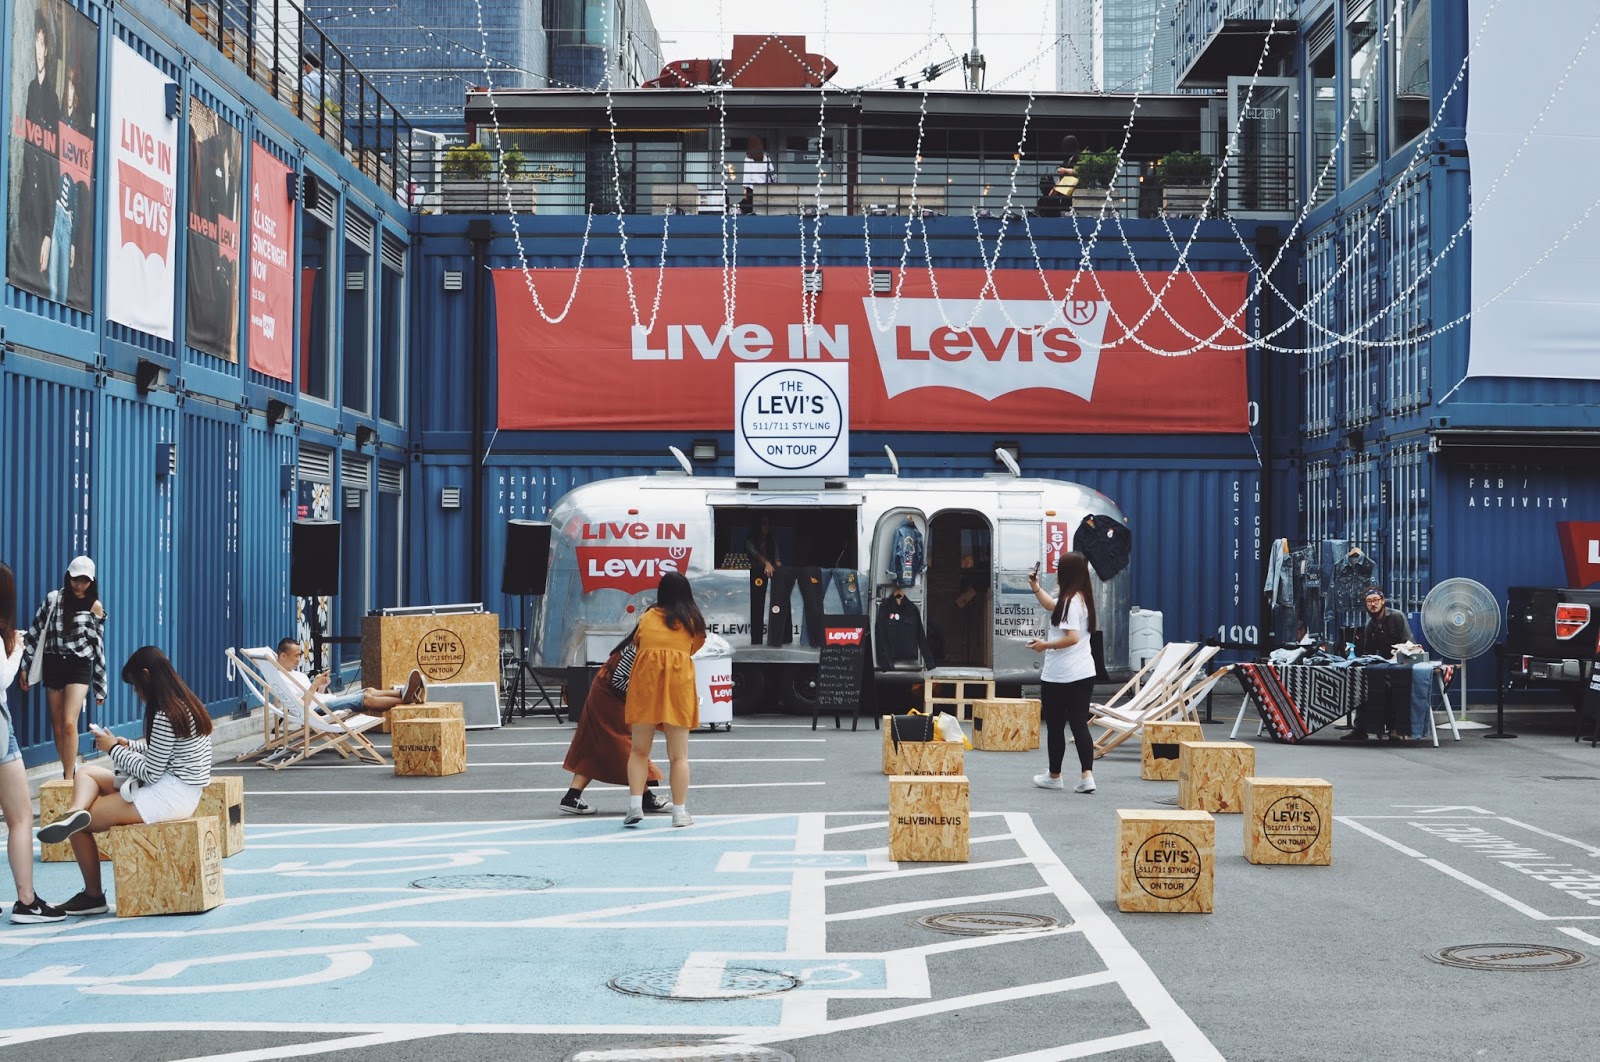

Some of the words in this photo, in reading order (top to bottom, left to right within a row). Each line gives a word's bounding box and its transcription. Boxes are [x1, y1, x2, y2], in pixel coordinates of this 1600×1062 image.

[158, 140, 171, 175] IN
[252, 258, 268, 282] NOW
[788, 324, 849, 360] IN
[779, 380, 804, 392] THE
[758, 396, 824, 414] LEVI'S
[752, 422, 789, 430] 511/711
[792, 422, 830, 430] STYLING
[766, 445, 783, 455] ON
[786, 445, 817, 455] TOUR
[500, 476, 556, 485] RETAIL
[1254, 481, 1260, 502] ID
[1469, 496, 1568, 508] ACTIVITY
[499, 506, 546, 514] ACTIV
[656, 523, 686, 540] IN
[722, 624, 750, 634] LEVI'
[1218, 625, 1258, 644] 199
[424, 642, 456, 652] LEVI'S
[898, 816, 962, 826] #LIVEINLEVIS
[1272, 812, 1310, 822] LEVI'S
[1145, 850, 1190, 863] LEVI'S
